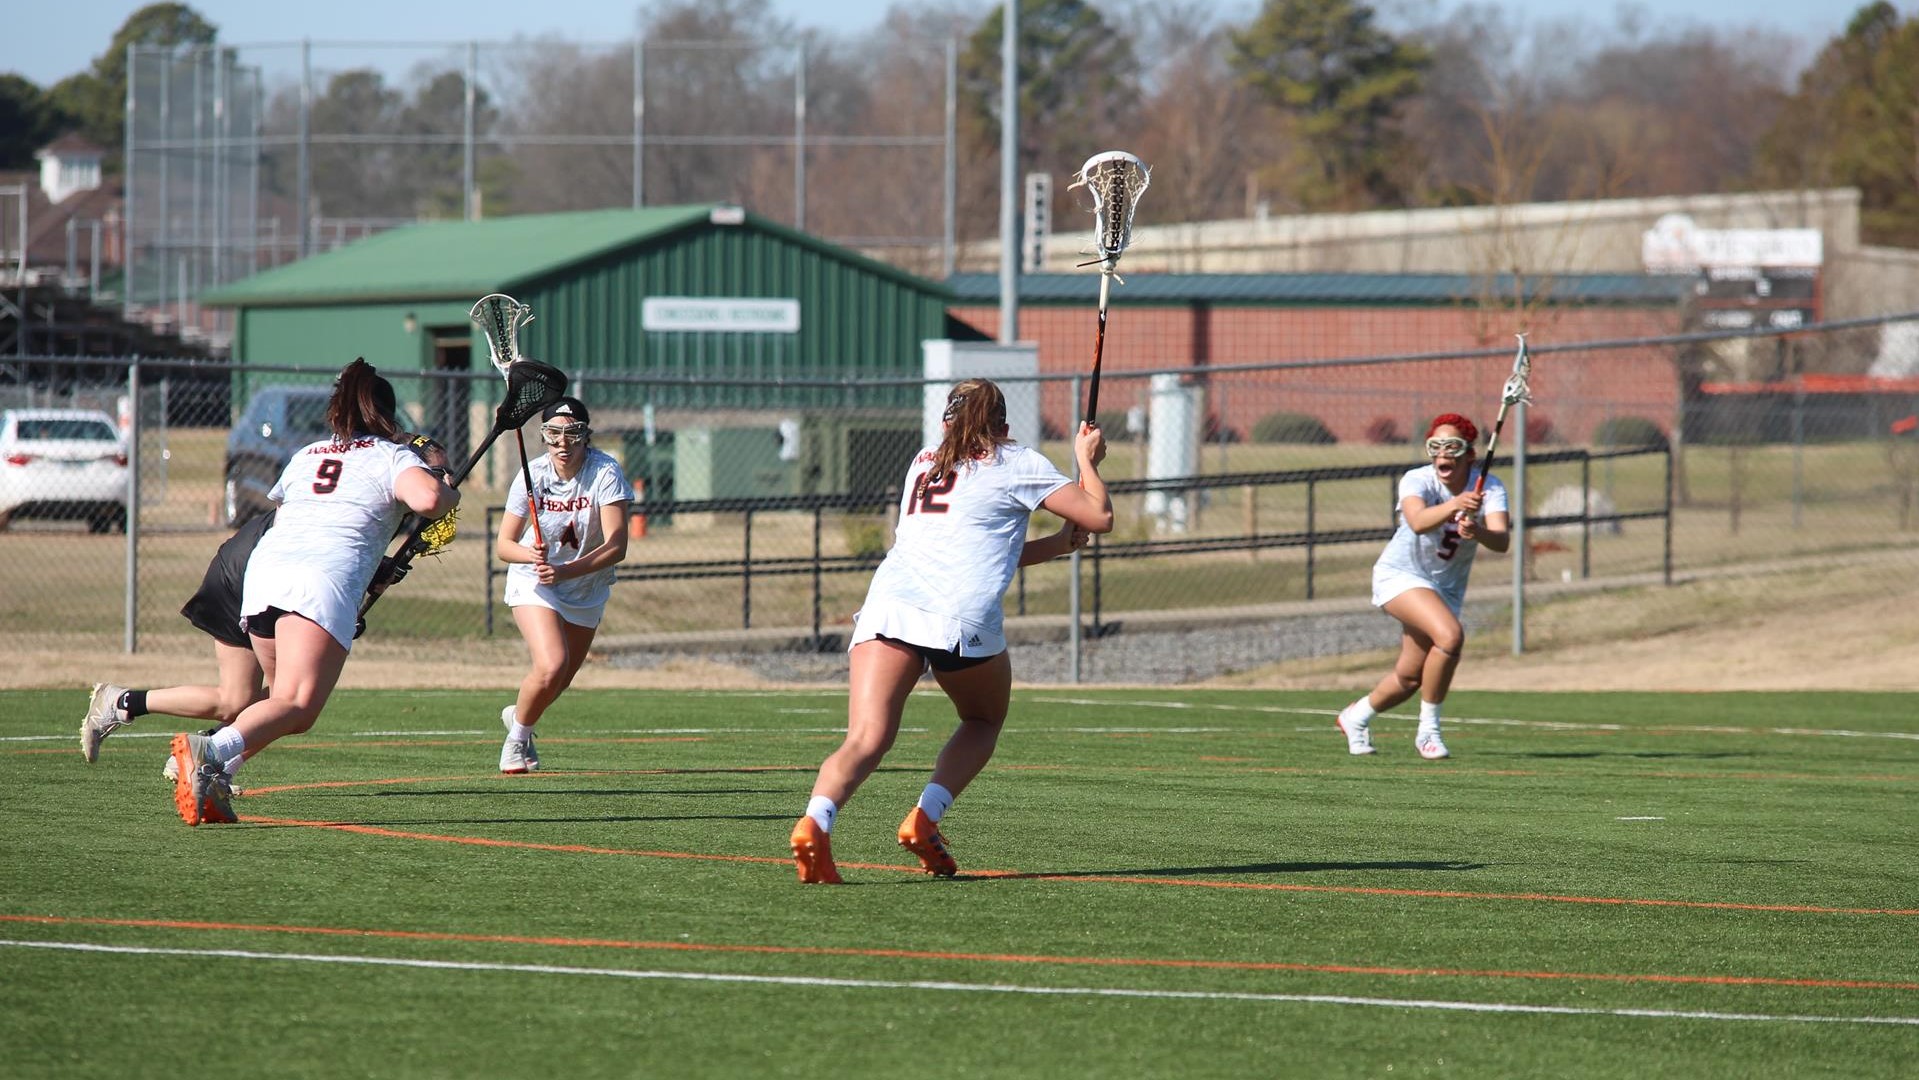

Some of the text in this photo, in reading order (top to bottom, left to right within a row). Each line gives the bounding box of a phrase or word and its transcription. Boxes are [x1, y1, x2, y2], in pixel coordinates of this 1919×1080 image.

[312, 458, 344, 495] 9
[907, 470, 958, 516] 12
[1437, 530, 1461, 561] 5
